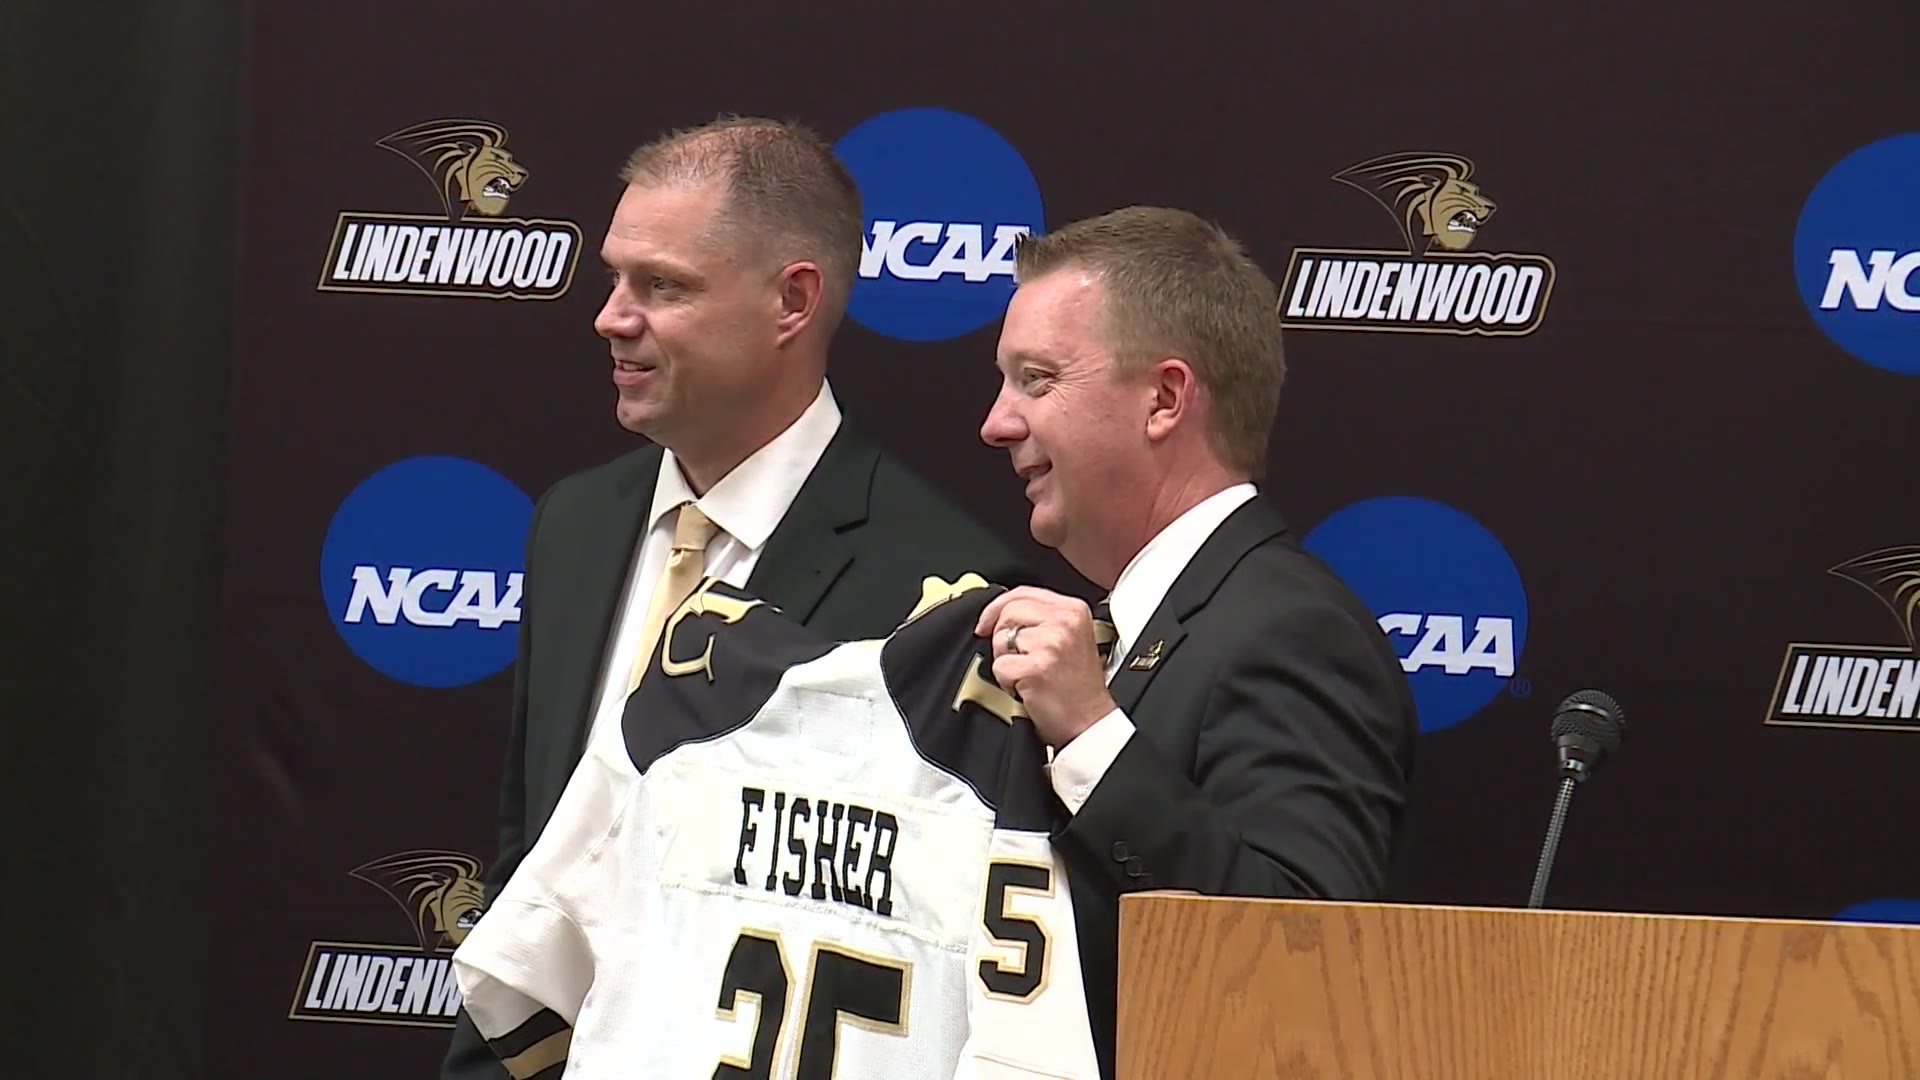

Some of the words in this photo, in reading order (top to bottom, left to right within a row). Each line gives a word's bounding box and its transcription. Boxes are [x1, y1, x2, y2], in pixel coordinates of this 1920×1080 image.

[332, 223, 571, 288] LINDENWOOD
[1819, 249, 1920, 311] NC
[1287, 259, 1543, 325] LINDENWOOD
[1377, 613, 1515, 677] CAA
[1781, 655, 1920, 719] LINDEN
[733, 786, 898, 916] FISHER
[976, 858, 1056, 1004] 5
[304, 953, 463, 1017] LINDENW
